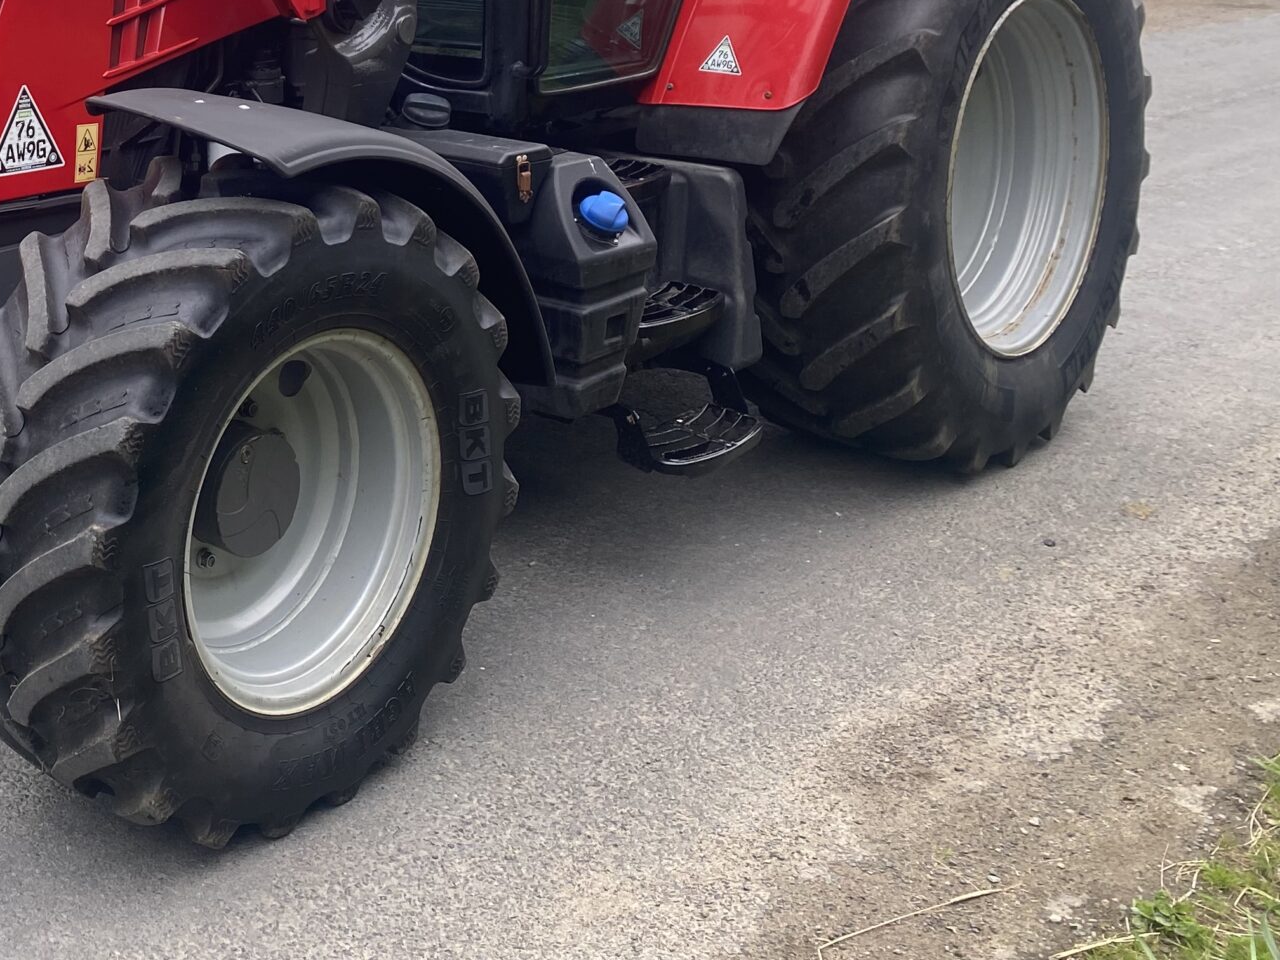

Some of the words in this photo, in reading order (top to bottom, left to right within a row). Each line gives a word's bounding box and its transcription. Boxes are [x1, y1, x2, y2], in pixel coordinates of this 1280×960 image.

[710, 59, 734, 70] AW9G
[718, 50, 729, 59] 76
[15, 119, 35, 141] 76
[5, 139, 47, 163] AW9G
[458, 389, 492, 497] BKT
[142, 558, 184, 684] BKT
